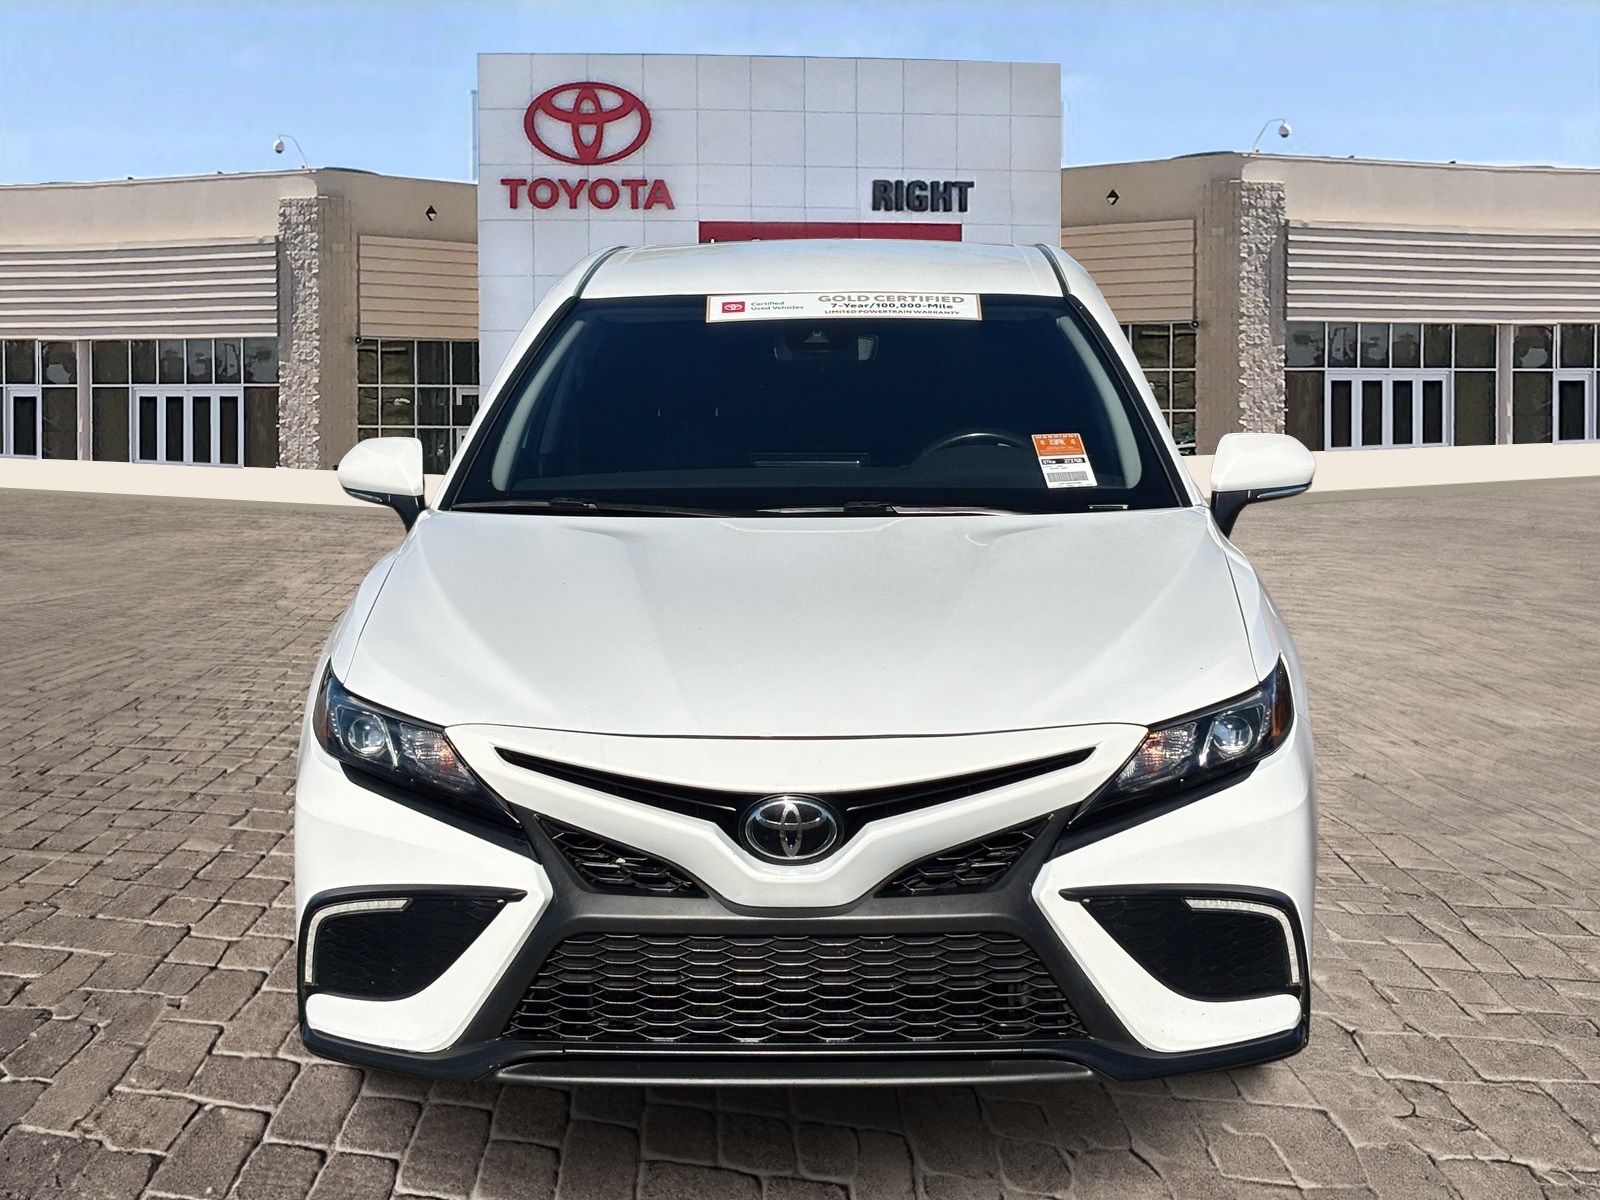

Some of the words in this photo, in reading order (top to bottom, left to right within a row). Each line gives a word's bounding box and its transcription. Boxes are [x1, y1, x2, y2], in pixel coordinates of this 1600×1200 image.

[500, 177, 675, 210] TOYOTA
[872, 179, 975, 213] RIGHT
[817, 295, 870, 303] GOLD
[873, 295, 965, 303] CERTIFIED
[830, 302, 954, 310] 7-Year/100,000-Mile
